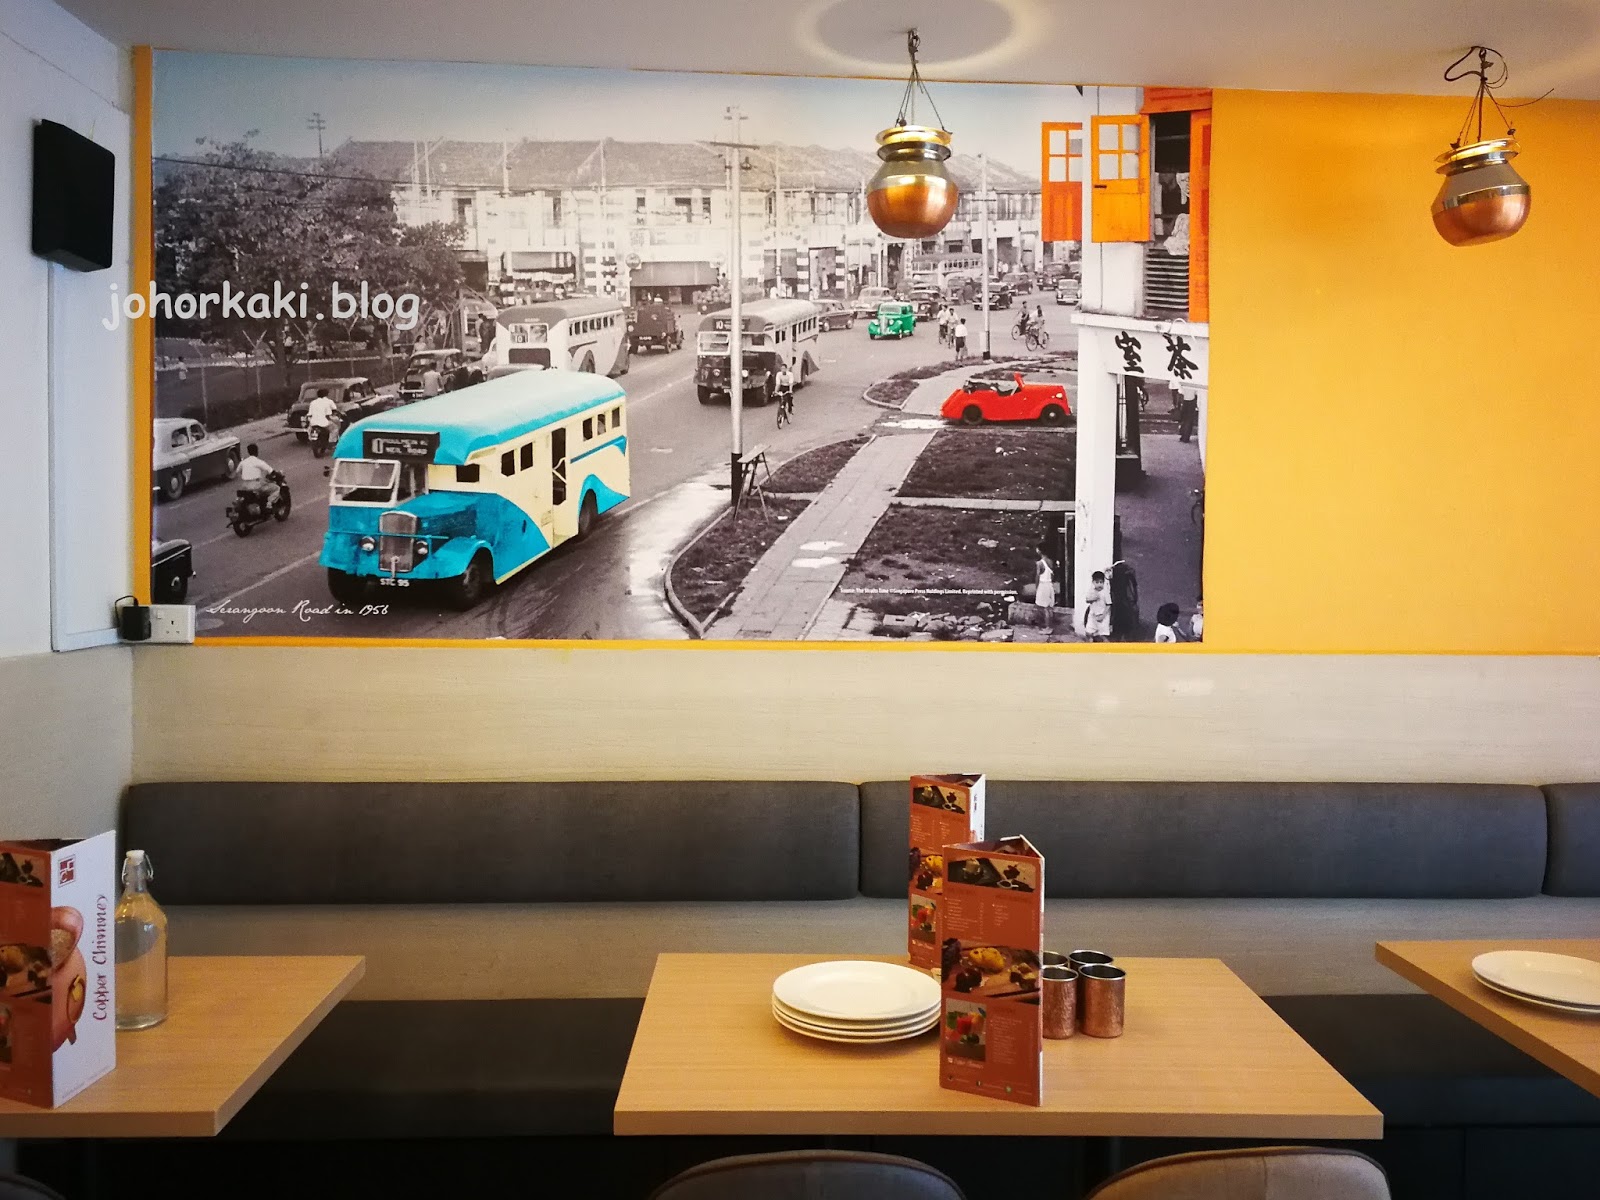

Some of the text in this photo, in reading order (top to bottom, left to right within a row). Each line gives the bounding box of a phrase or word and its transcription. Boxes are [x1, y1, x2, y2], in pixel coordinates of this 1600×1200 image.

[291, 599, 334, 622] Road
[335, 603, 353, 615] in
[359, 604, 390, 616] 1956
[91, 894, 109, 1021] Copper Chimney
